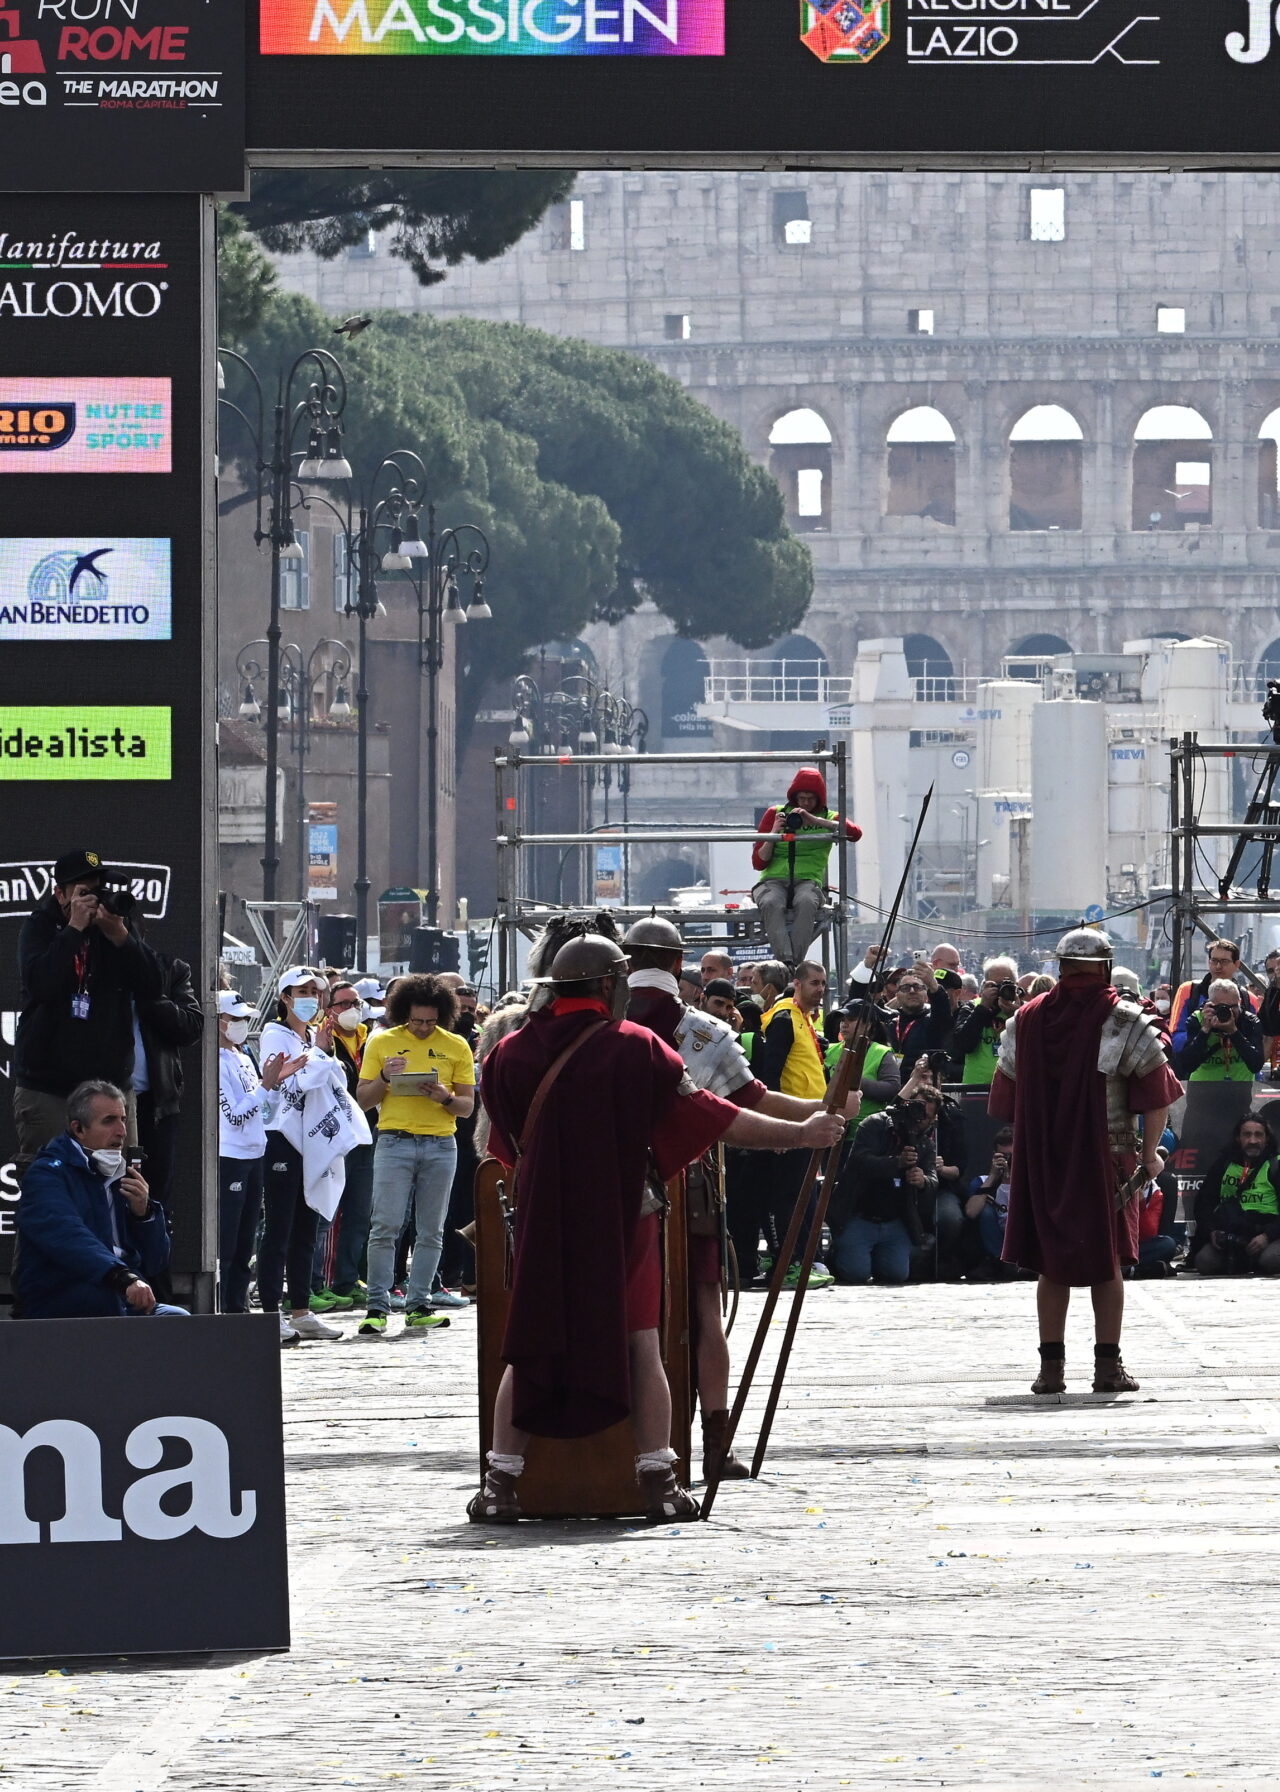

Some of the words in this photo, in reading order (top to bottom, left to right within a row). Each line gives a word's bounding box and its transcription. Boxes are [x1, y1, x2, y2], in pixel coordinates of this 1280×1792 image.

[308, 0, 678, 45] MASSIGEN
[57, 26, 189, 61] ROME
[906, 26, 1019, 57] LAZIO
[64, 80, 93, 94] THE
[98, 80, 218, 98] MARATHON
[100, 100, 134, 109] ROMA
[135, 100, 187, 109] CAPITALE
[85, 403, 164, 419] NUTRE
[85, 433, 164, 449] SPORT
[0, 727, 146, 758] dealista
